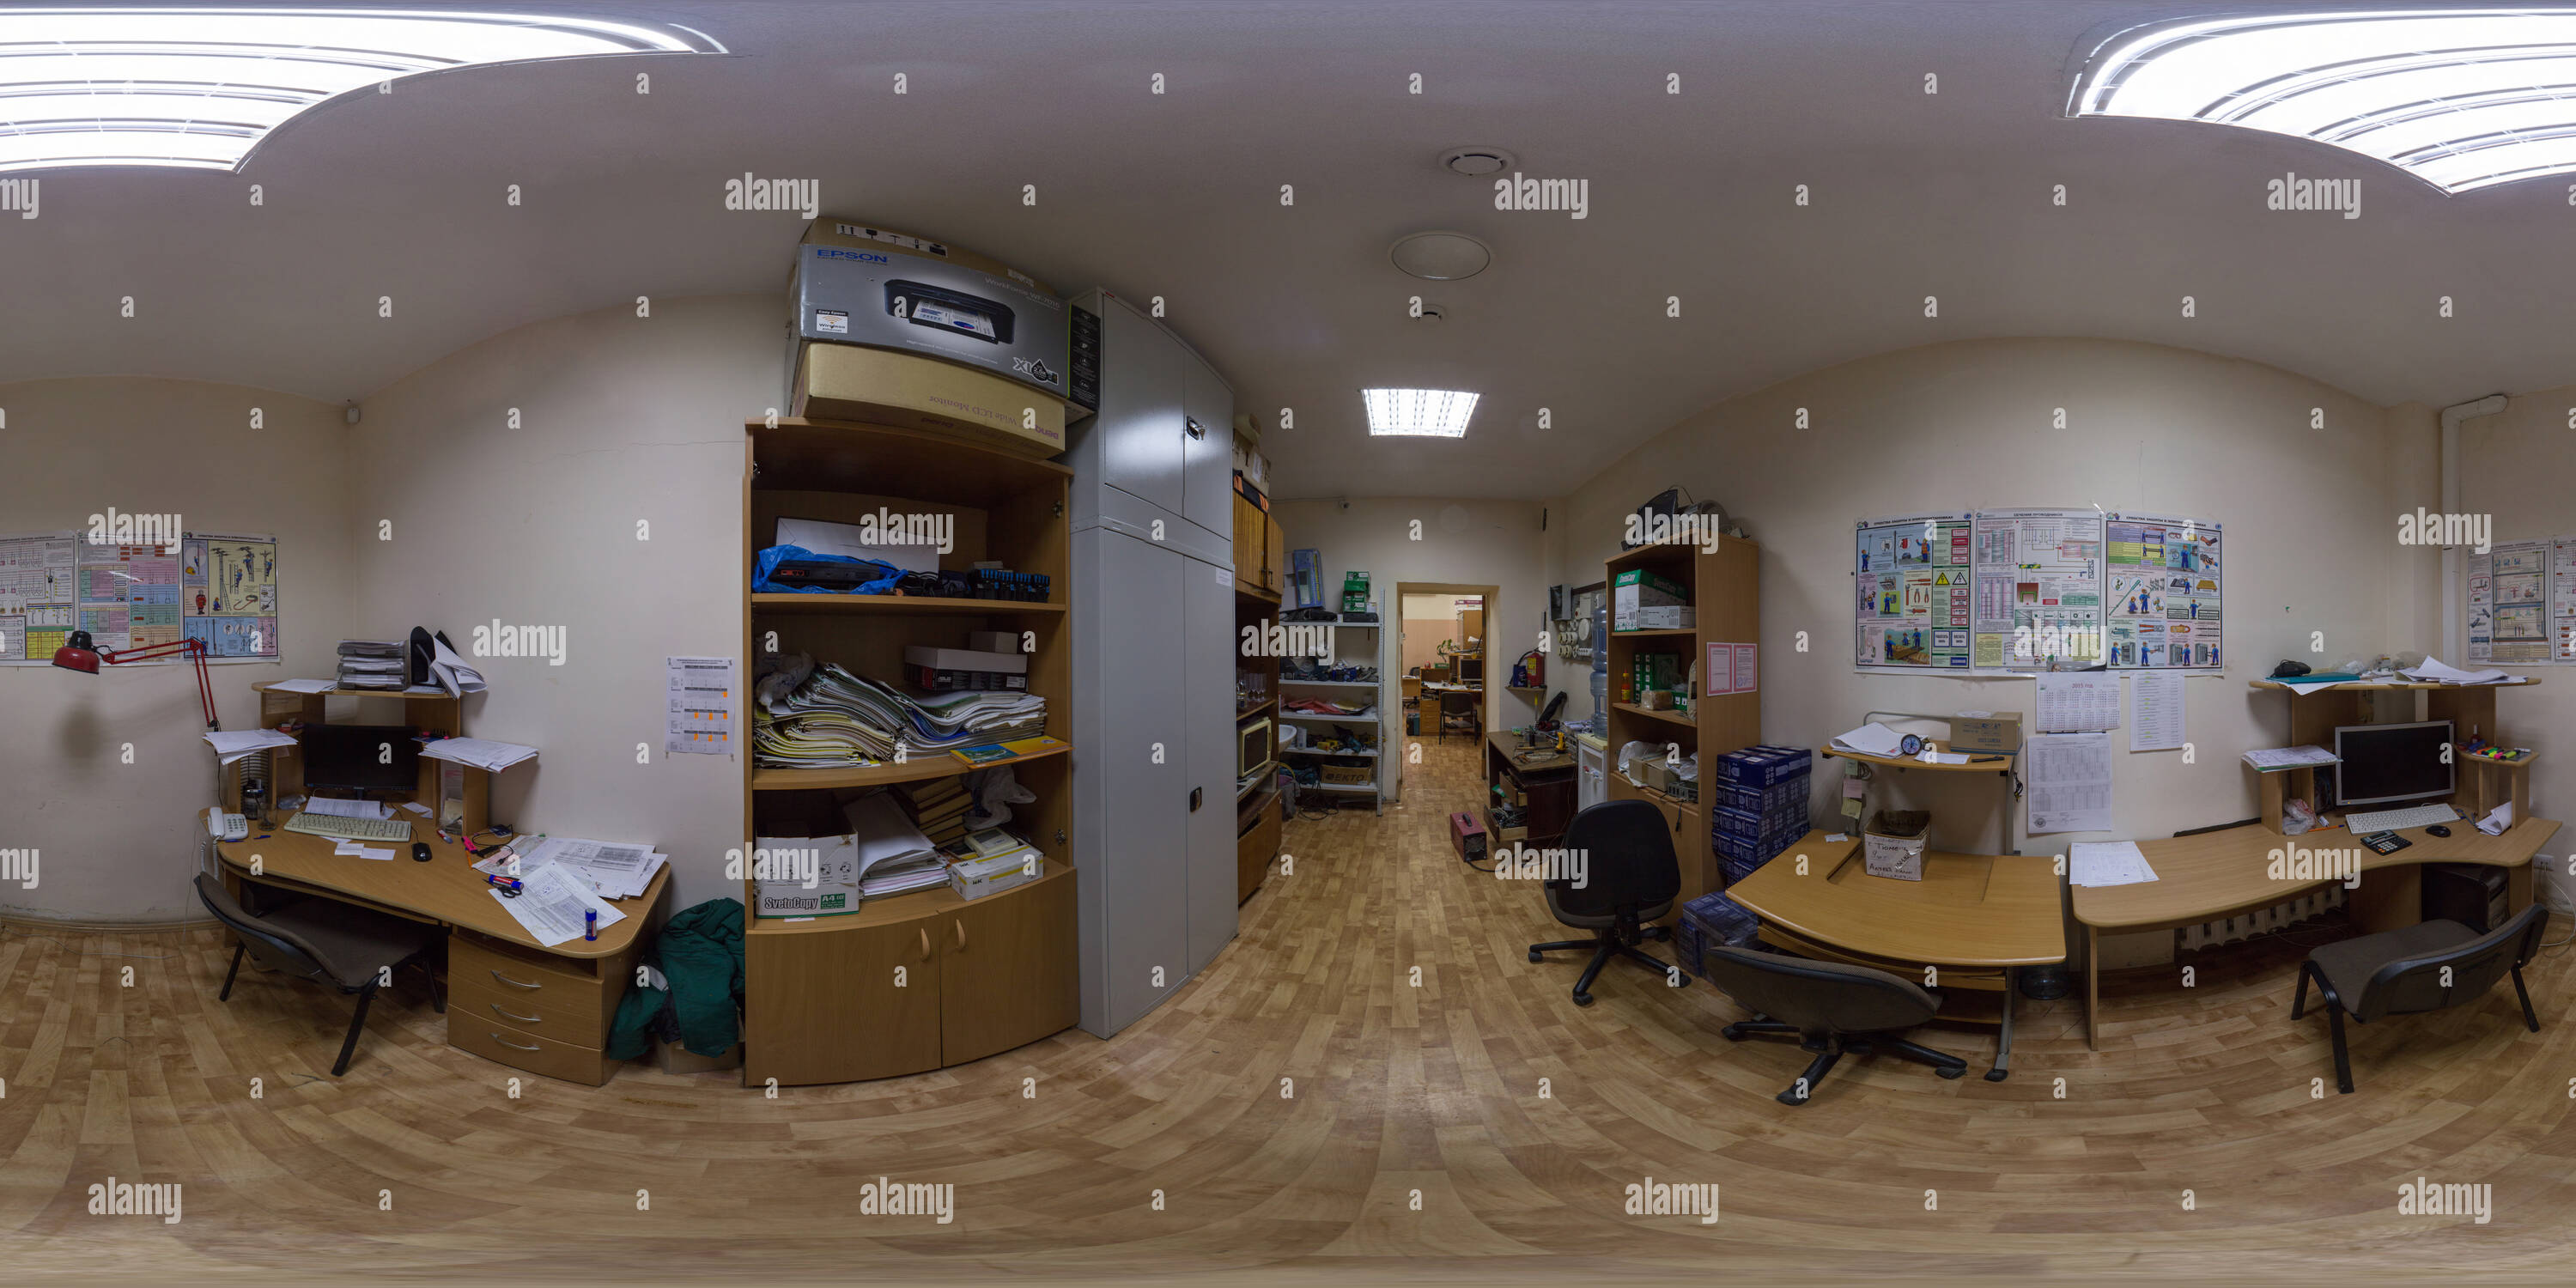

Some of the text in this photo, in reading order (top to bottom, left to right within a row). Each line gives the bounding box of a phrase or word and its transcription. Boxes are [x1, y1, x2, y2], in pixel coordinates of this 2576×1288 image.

[817, 249, 887, 263] EPSON
[929, 395, 969, 413] Monitor
[972, 407, 993, 419] LCD
[995, 412, 1017, 426] Wide
[764, 896, 818, 910] SvetoCopy
[822, 894, 835, 902] A4
